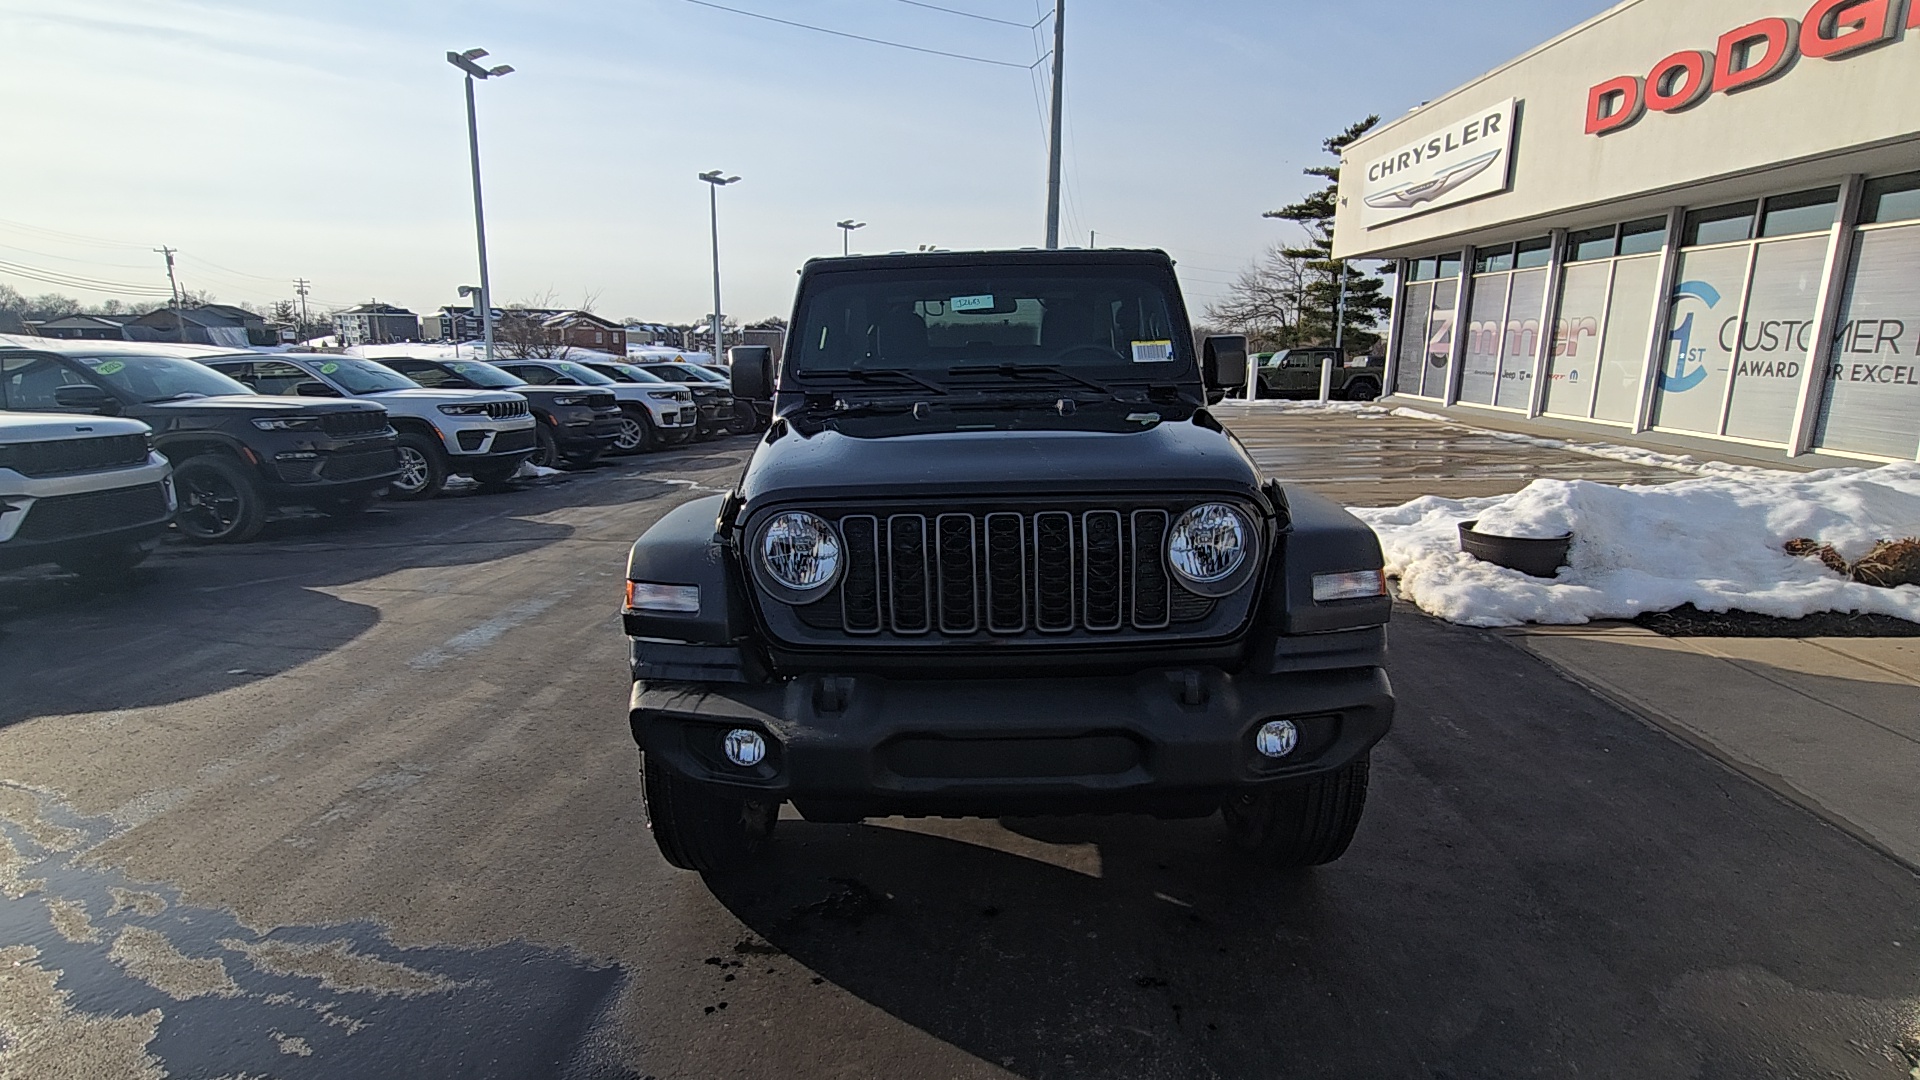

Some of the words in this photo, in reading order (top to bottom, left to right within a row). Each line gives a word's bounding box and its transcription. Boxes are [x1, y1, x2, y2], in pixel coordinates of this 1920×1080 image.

[1585, 0, 1920, 136] DODG
[1368, 112, 1502, 182] CHRYSLER
[1430, 309, 1597, 358] Zmmer
[1737, 361, 1800, 379] AWARD
